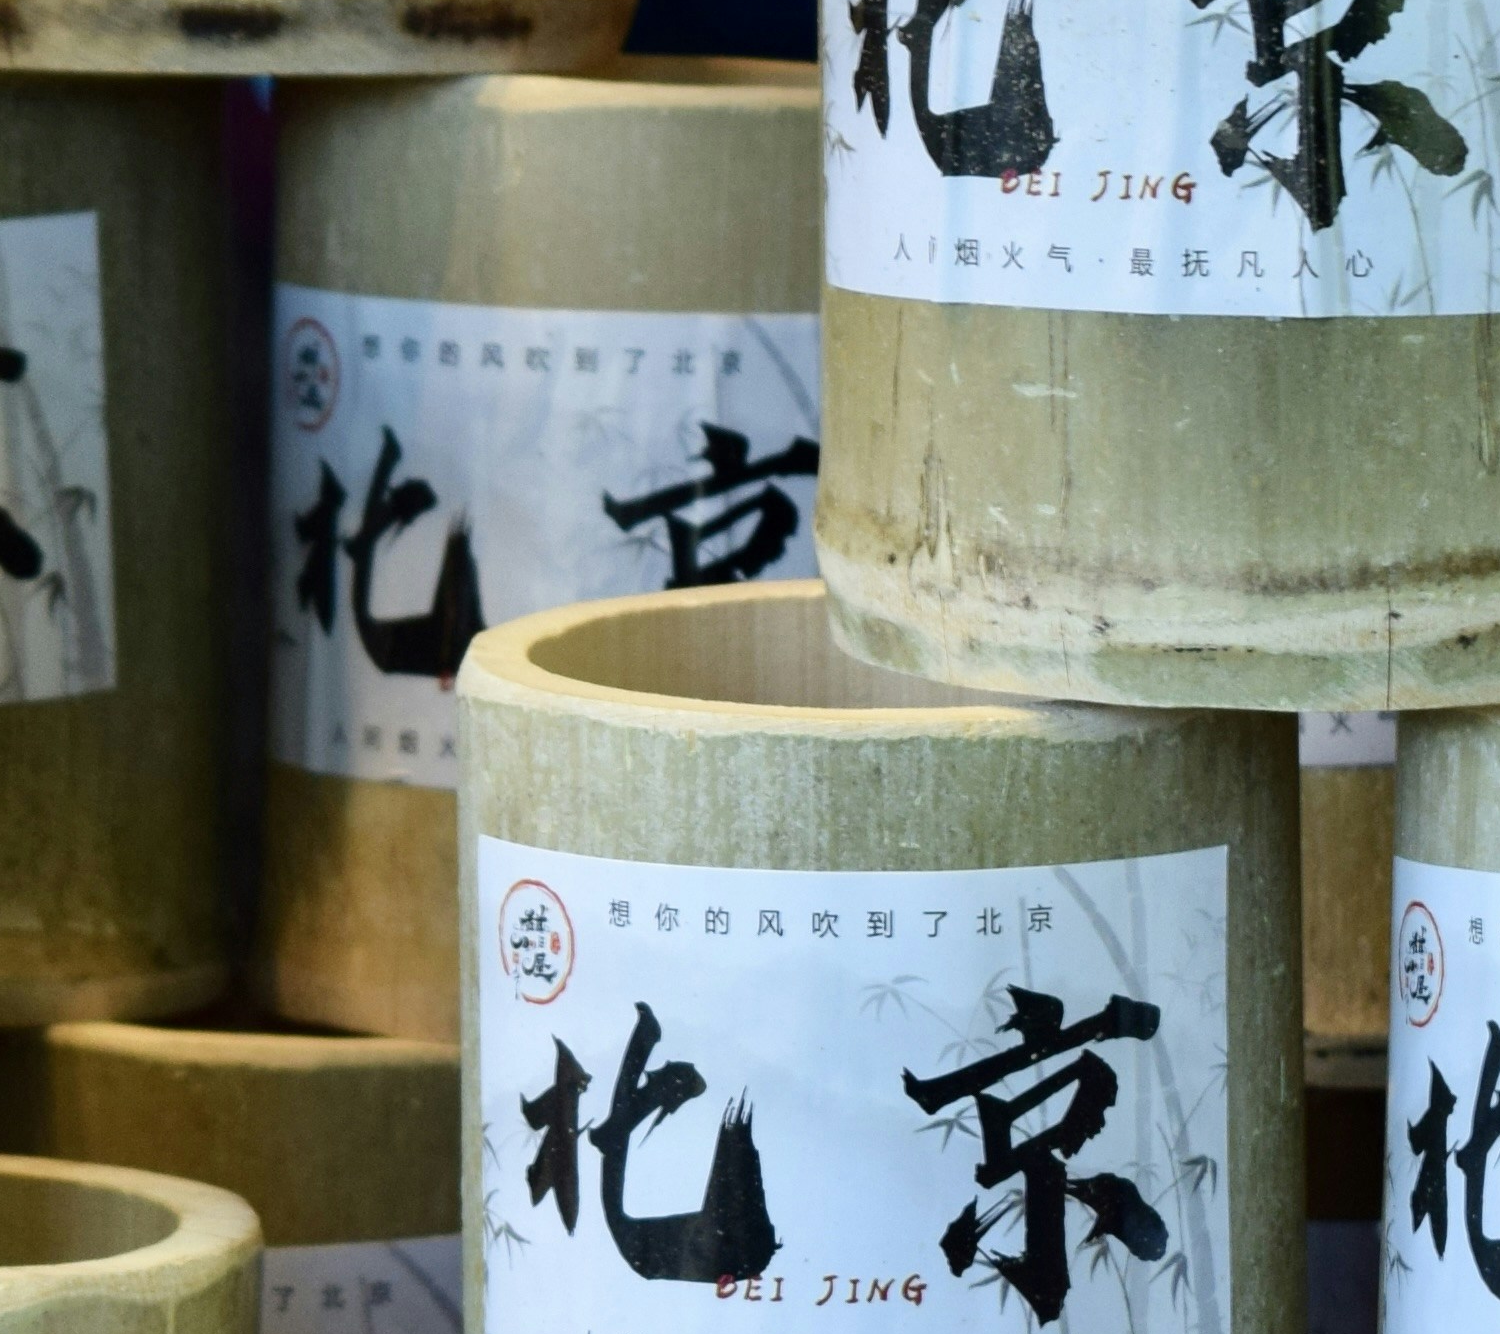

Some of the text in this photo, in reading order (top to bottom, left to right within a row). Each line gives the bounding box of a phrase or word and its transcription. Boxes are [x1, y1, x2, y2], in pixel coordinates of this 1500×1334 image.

[999, 171, 1198, 205] BEI JING
[607, 898, 1054, 939] 想你的风吹到了北京
[520, 983, 1170, 1328] 北京
[715, 1274, 928, 1306] BEI JING
